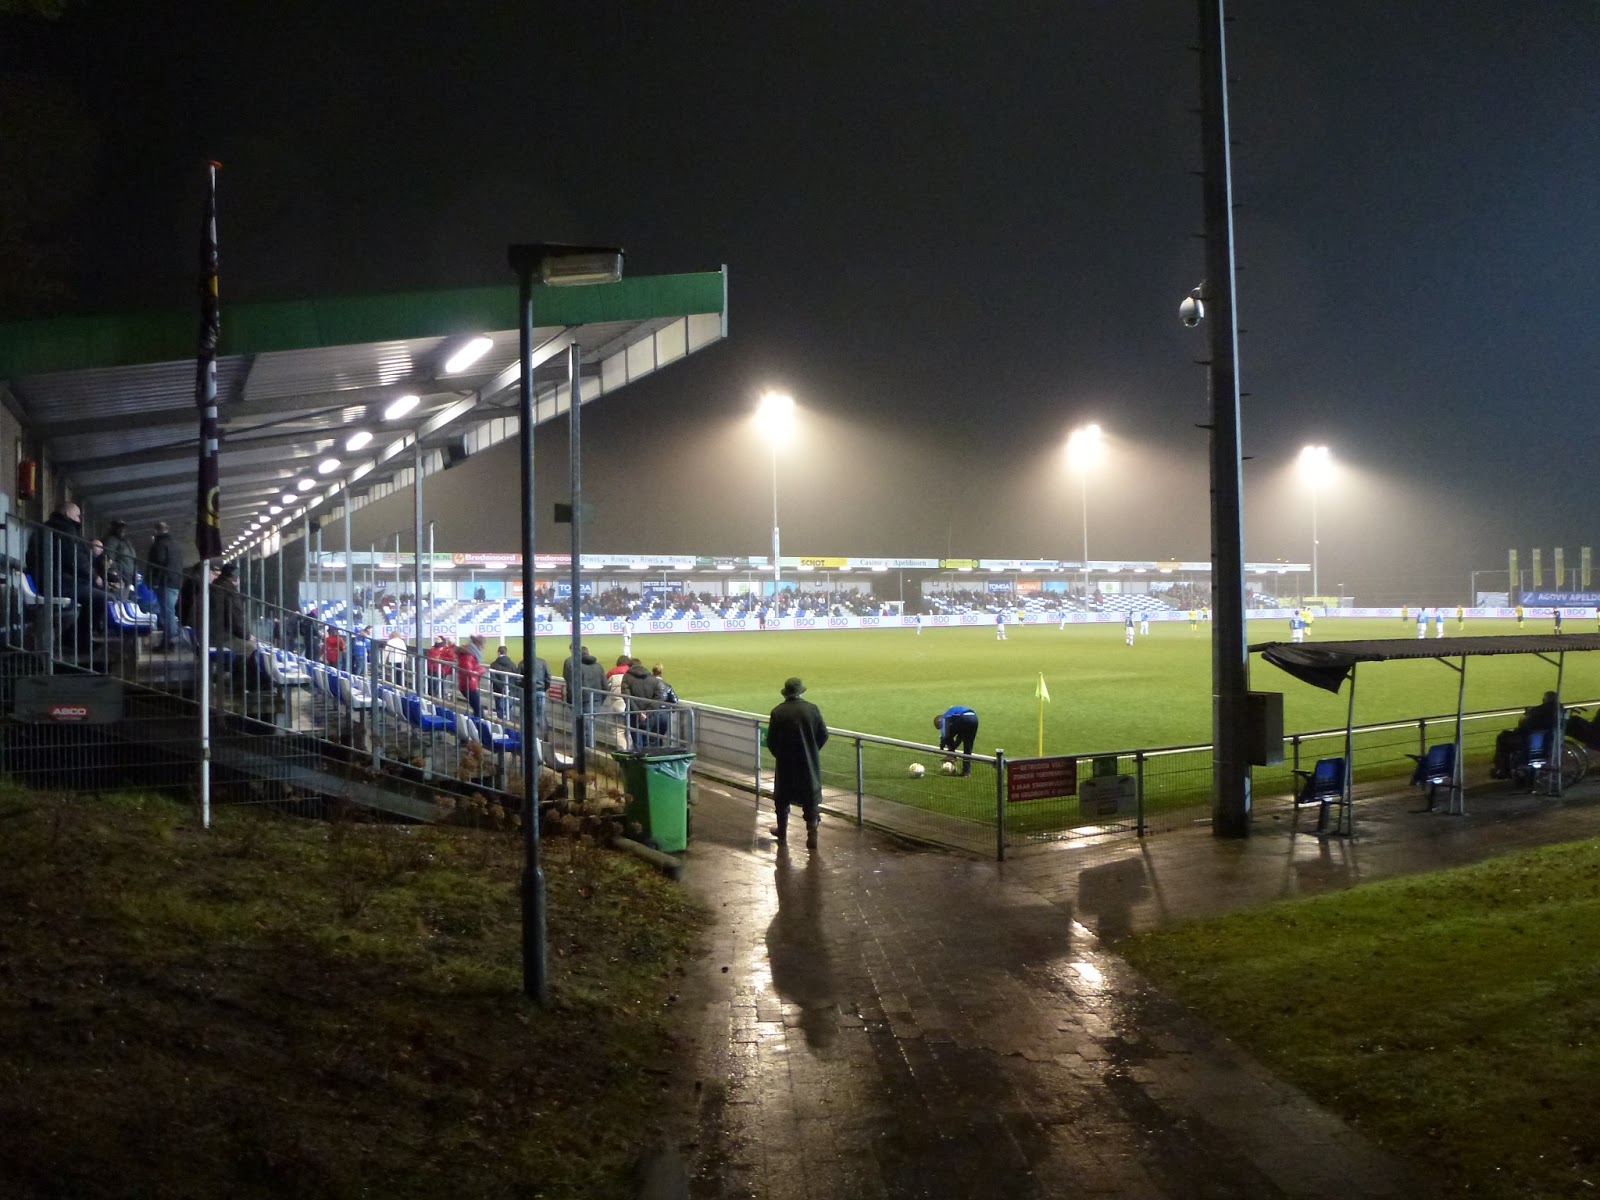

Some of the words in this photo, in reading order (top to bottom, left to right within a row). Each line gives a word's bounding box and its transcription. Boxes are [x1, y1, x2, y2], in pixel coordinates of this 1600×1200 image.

[465, 554, 516, 562] Bredenoord
[800, 559, 826, 567] SCHOT
[893, 559, 927, 568] Apeldoorn
[1567, 608, 1587, 616] BDO
[726, 619, 746, 628] BDO
[767, 618, 781, 627] DO
[796, 618, 816, 626] BDO
[830, 617, 849, 626] BDO
[862, 617, 880, 625] BDO
[933, 615, 950, 624] BDO
[962, 615, 978, 623] BDO
[534, 623, 554, 632] DO
[580, 622, 595, 631] DO
[652, 621, 674, 630] BDO
[690, 620, 711, 629] BDO
